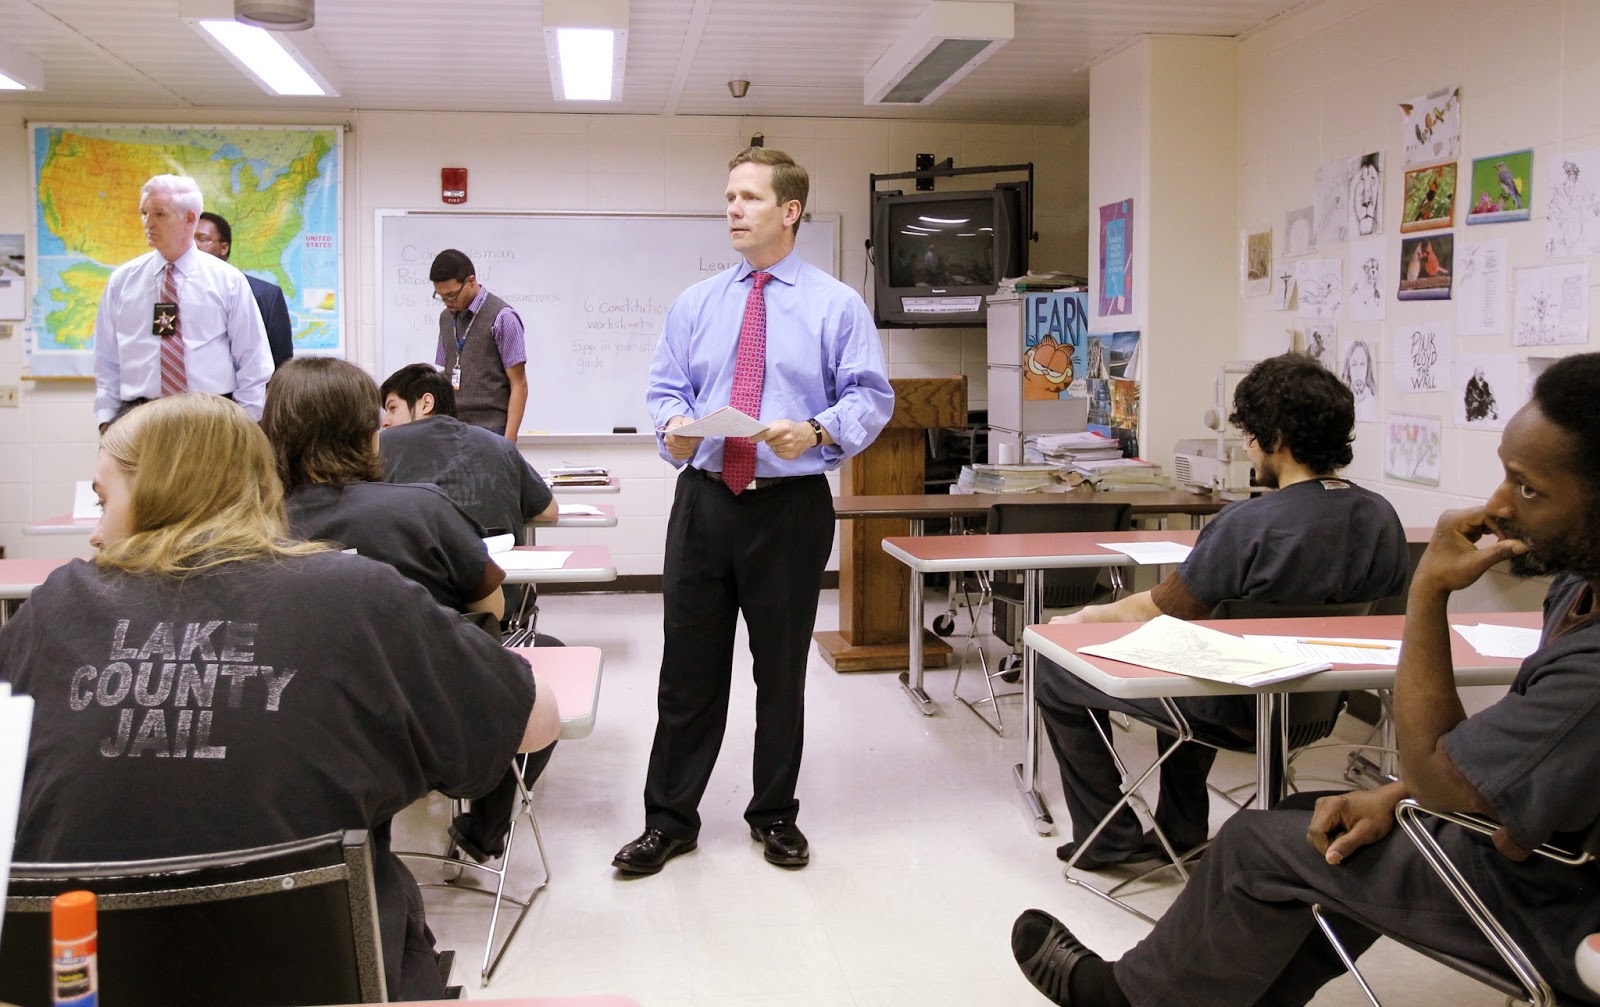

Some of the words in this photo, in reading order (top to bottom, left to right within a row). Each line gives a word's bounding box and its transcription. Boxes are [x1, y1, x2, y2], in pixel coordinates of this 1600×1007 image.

[1410, 331, 1437, 354] PINK
[1411, 351, 1438, 368] FLOYD
[1410, 376, 1437, 390] WALL
[1416, 367, 1430, 377] THE
[109, 618, 259, 662] LAKE
[69, 661, 298, 712] COUNTY
[99, 708, 228, 760] JAIL
